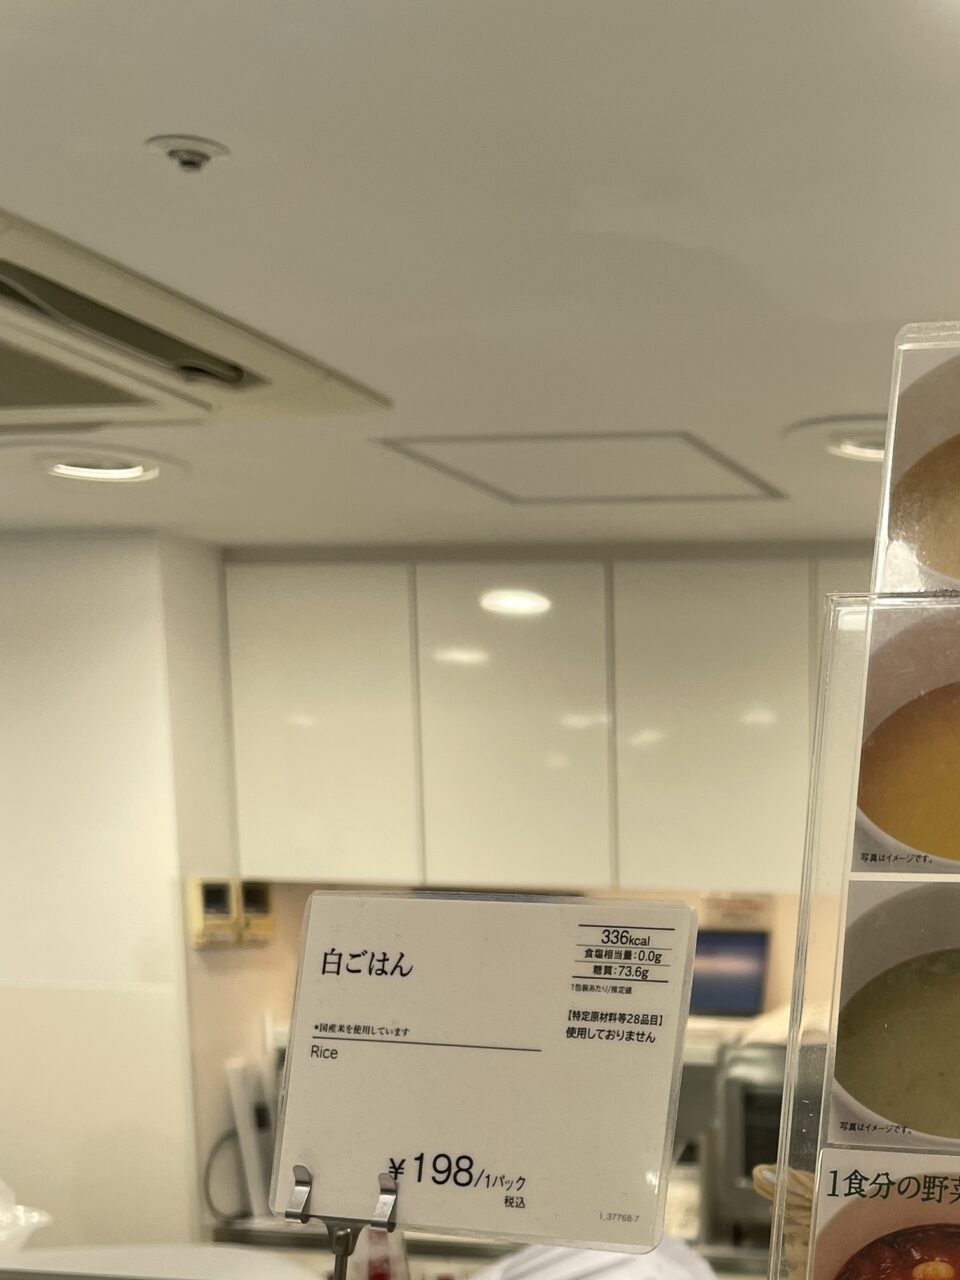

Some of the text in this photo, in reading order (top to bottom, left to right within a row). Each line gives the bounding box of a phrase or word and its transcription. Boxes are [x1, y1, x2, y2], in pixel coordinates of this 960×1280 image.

[600, 928, 651, 947] 336kcal
[320, 947, 415, 978] 白ごはん
[565, 1025, 657, 1044] 使用しておりません
[309, 1043, 339, 1060] Rice
[503, 1194, 527, 1210] 税込
